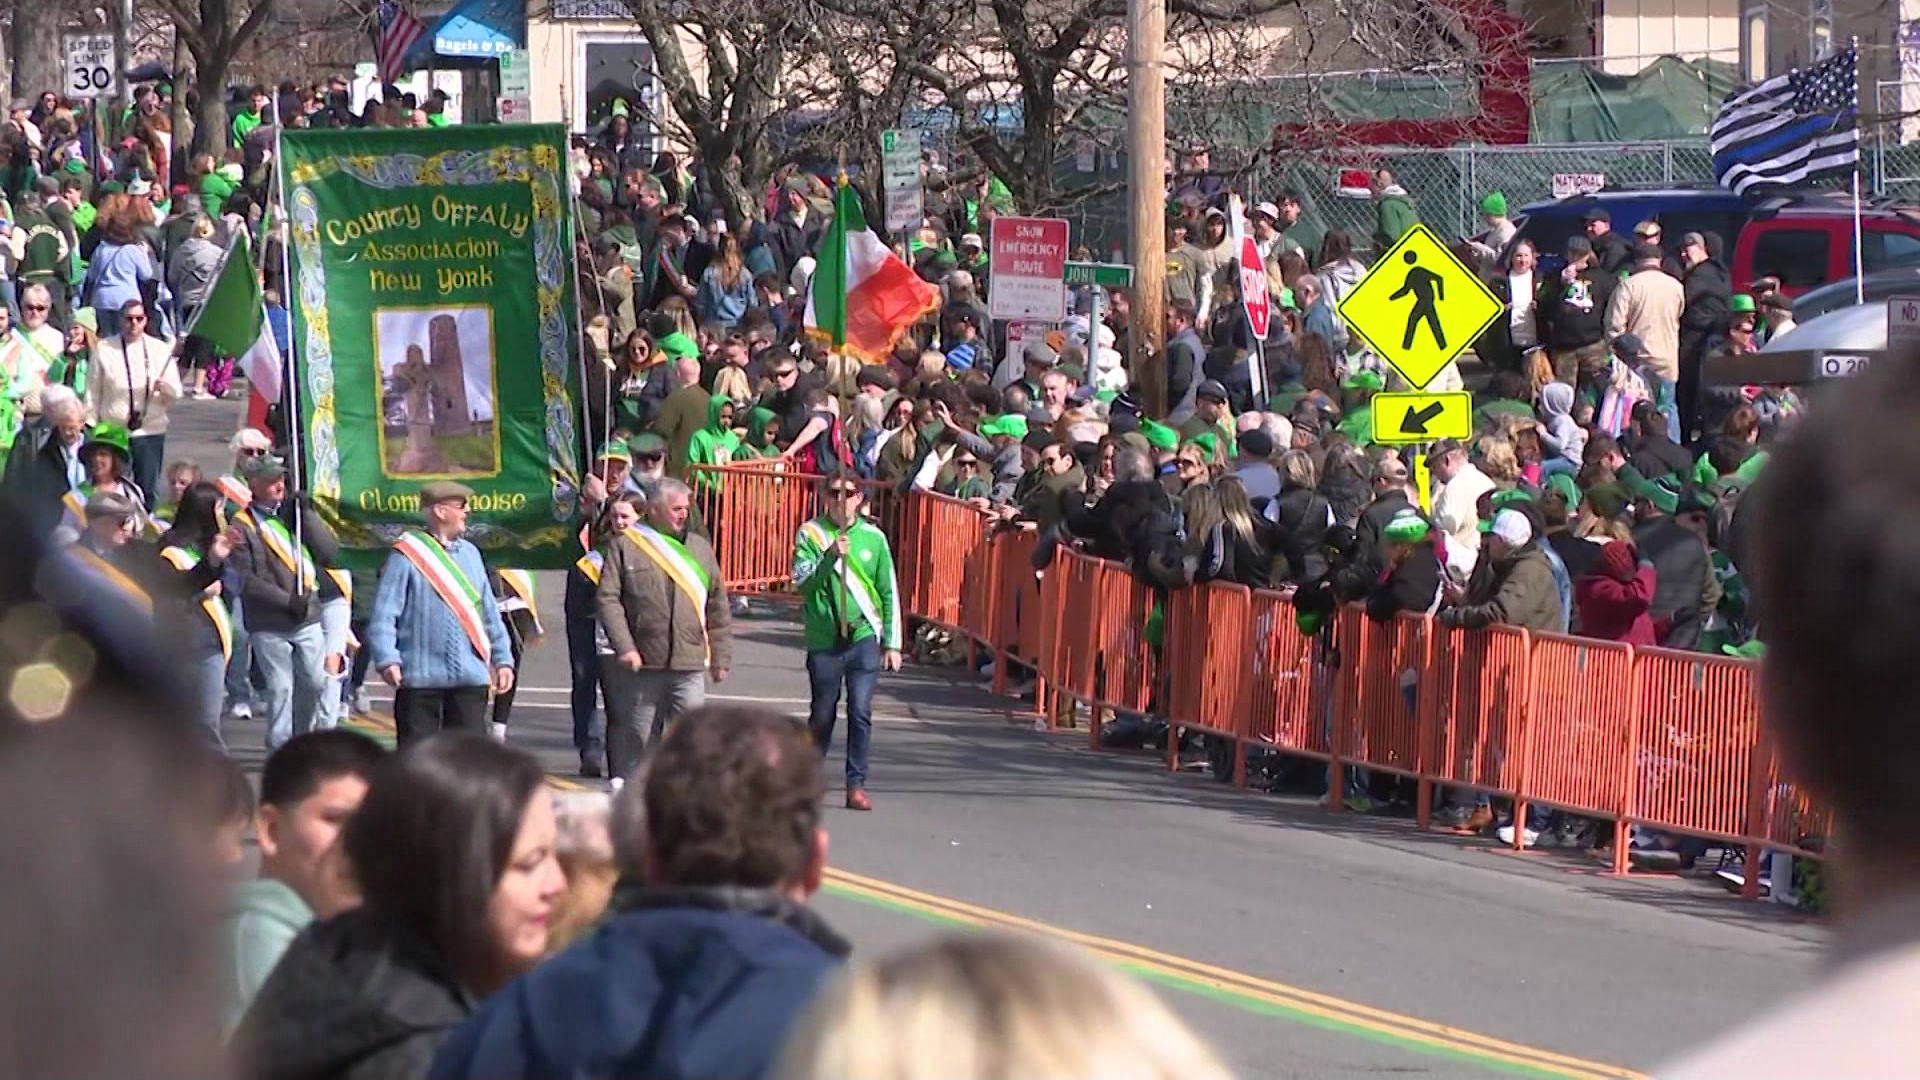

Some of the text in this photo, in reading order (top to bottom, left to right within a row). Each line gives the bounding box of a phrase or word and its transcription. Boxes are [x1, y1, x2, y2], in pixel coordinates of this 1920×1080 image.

[69, 40, 111, 52] SPEED
[436, 37, 478, 53] Bagels
[74, 53, 107, 64] LIMIT
[73, 66, 110, 90] 30
[1555, 175, 1602, 187] NATIONAL
[325, 203, 422, 246] County
[1015, 224, 1046, 238] SNOW
[999, 242, 1060, 256] EMERGENCY
[1013, 260, 1045, 273] ROUTE
[1065, 265, 1096, 283] JOHN
[1241, 266, 1265, 305] STOP
